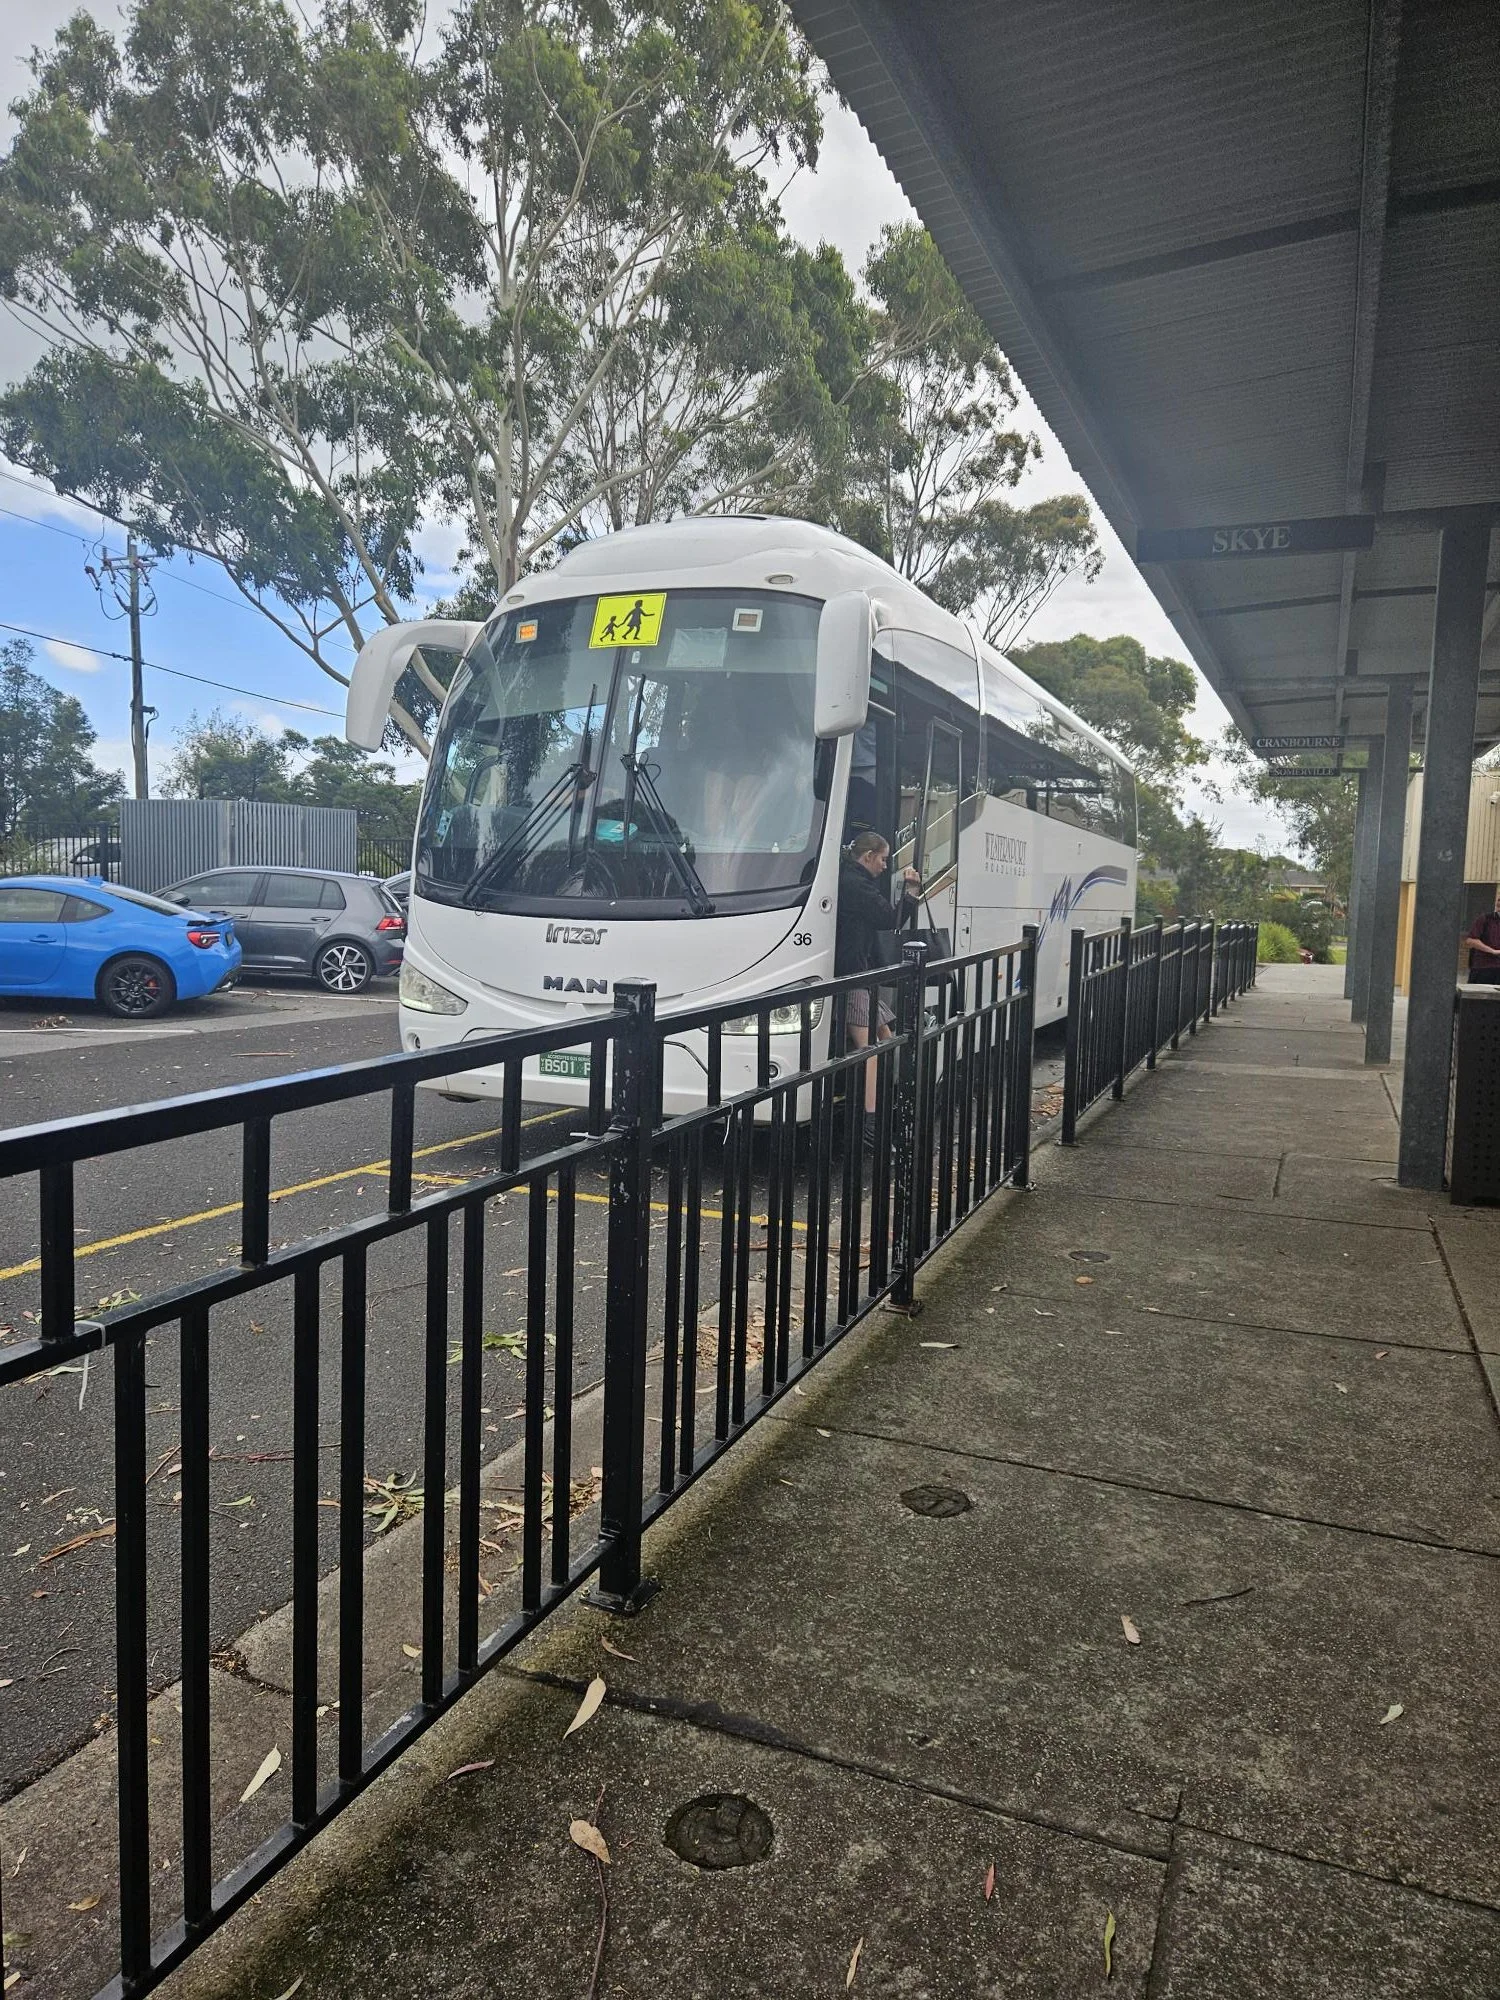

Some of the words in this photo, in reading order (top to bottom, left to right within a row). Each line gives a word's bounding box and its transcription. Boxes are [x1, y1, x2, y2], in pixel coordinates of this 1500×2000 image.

[1212, 526, 1292, 553] SKYE
[1256, 737, 1340, 748] CRANBOURNE
[1274, 768, 1334, 776] SOMERVILLE
[545, 923, 608, 945] Irizar
[793, 932, 812, 946] 36
[543, 975, 608, 994] MAN
